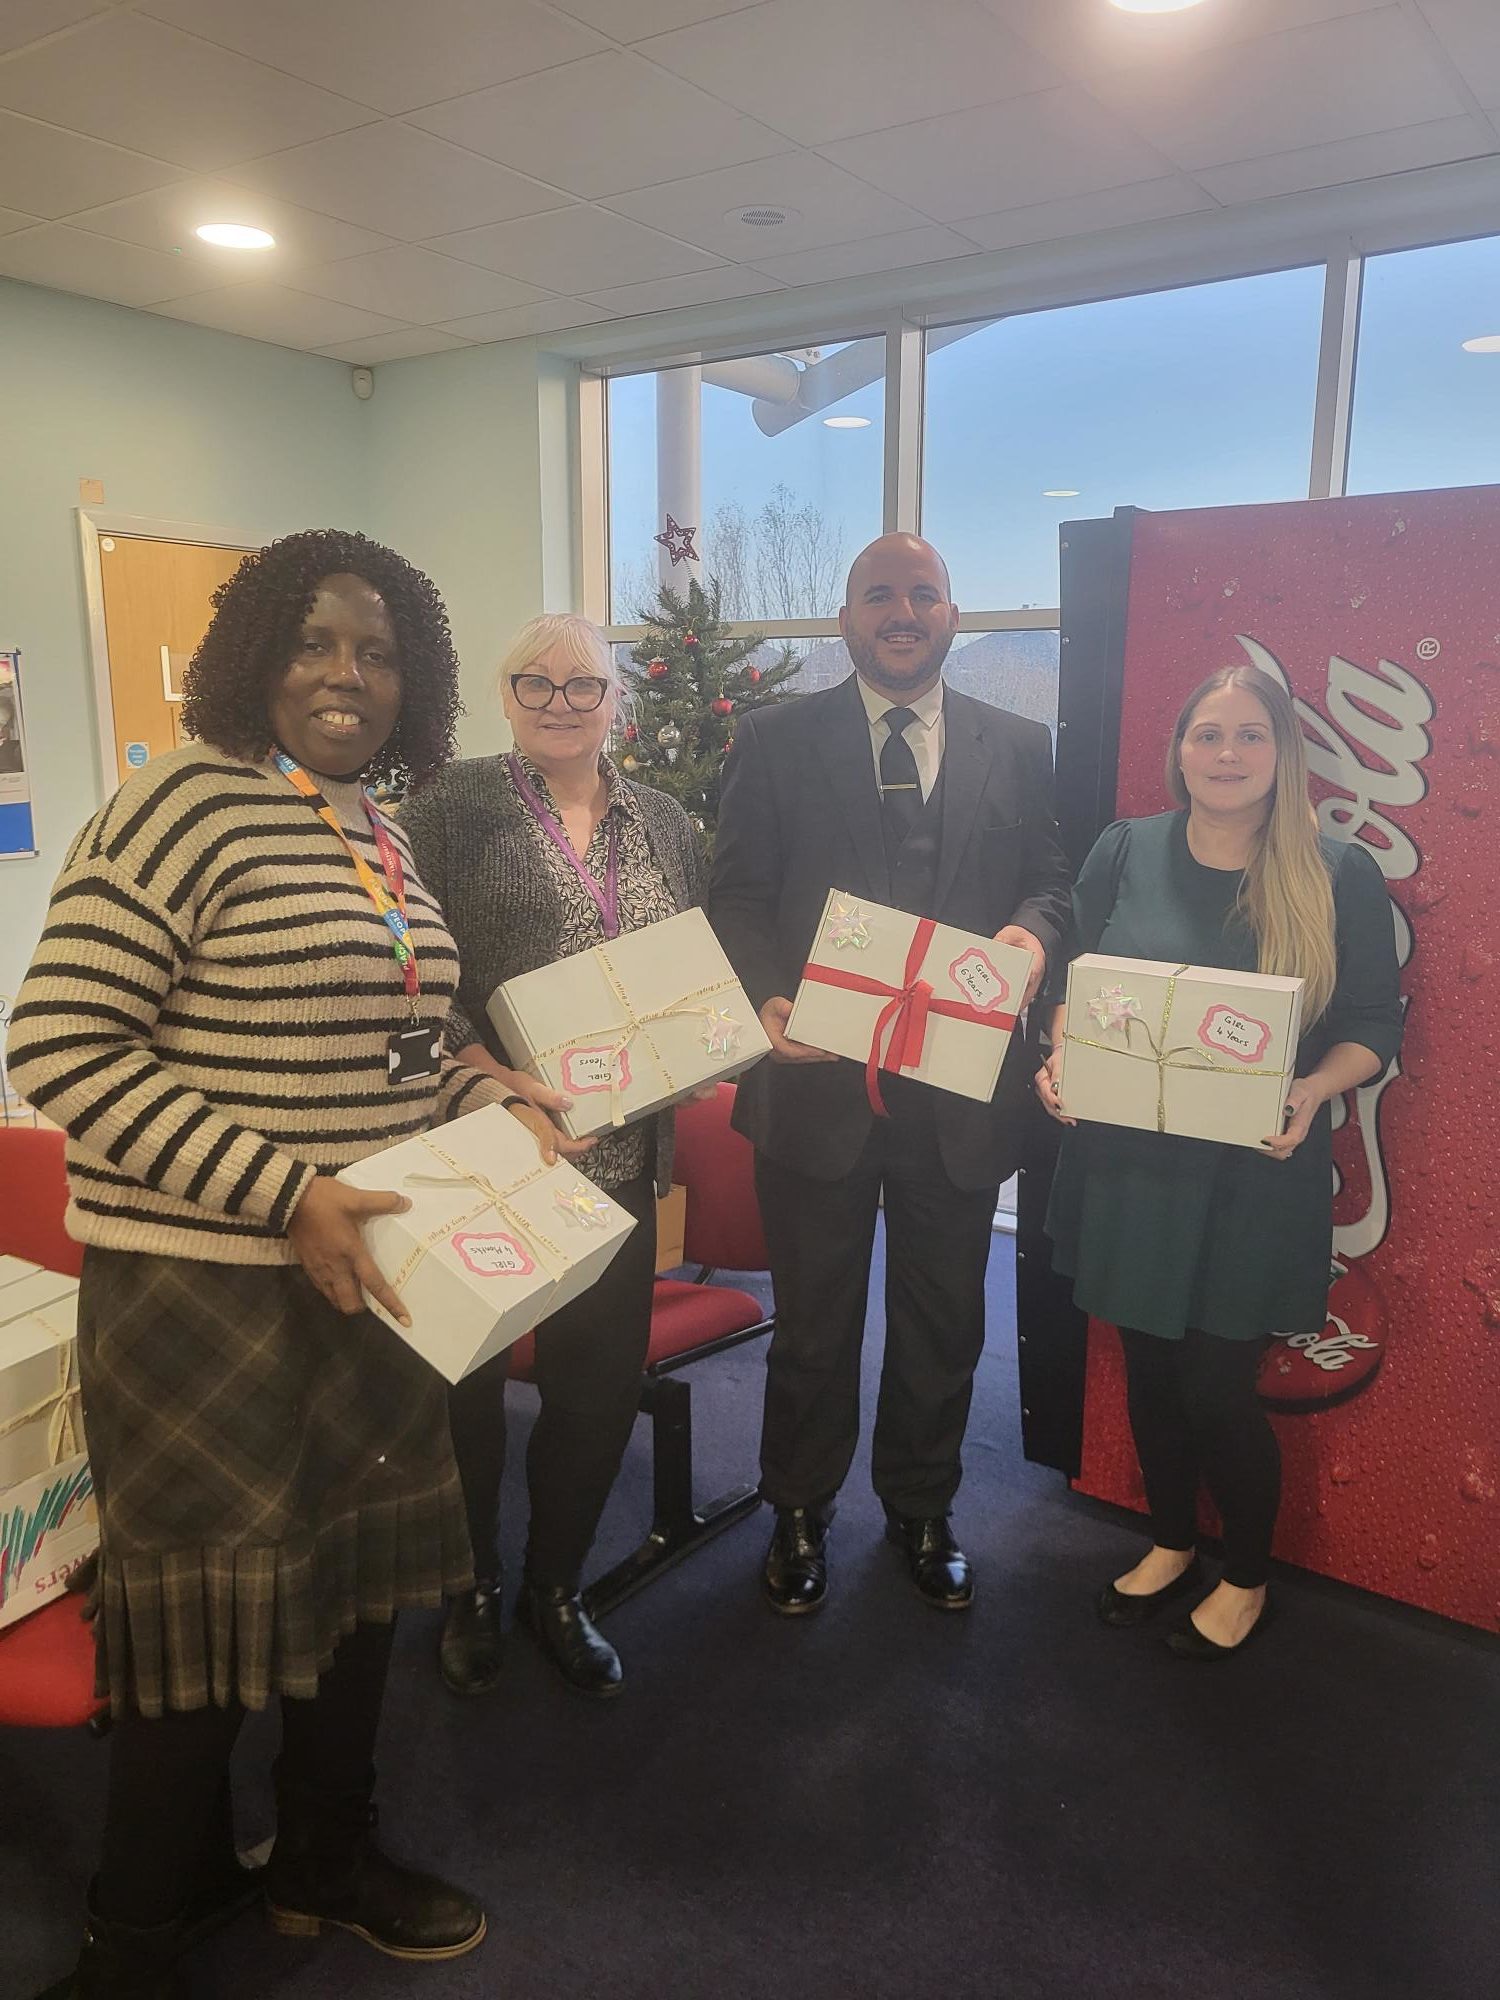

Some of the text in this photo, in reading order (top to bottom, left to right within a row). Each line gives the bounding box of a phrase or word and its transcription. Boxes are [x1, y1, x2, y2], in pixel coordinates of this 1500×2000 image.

[1224, 1015, 1246, 1031] GIRL
[1226, 1030, 1250, 1047] Years
[579, 1057, 606, 1069] Years
[587, 1072, 612, 1081] GIRL
[469, 1245, 505, 1256] Months
[491, 1260, 516, 1270] GIRL
